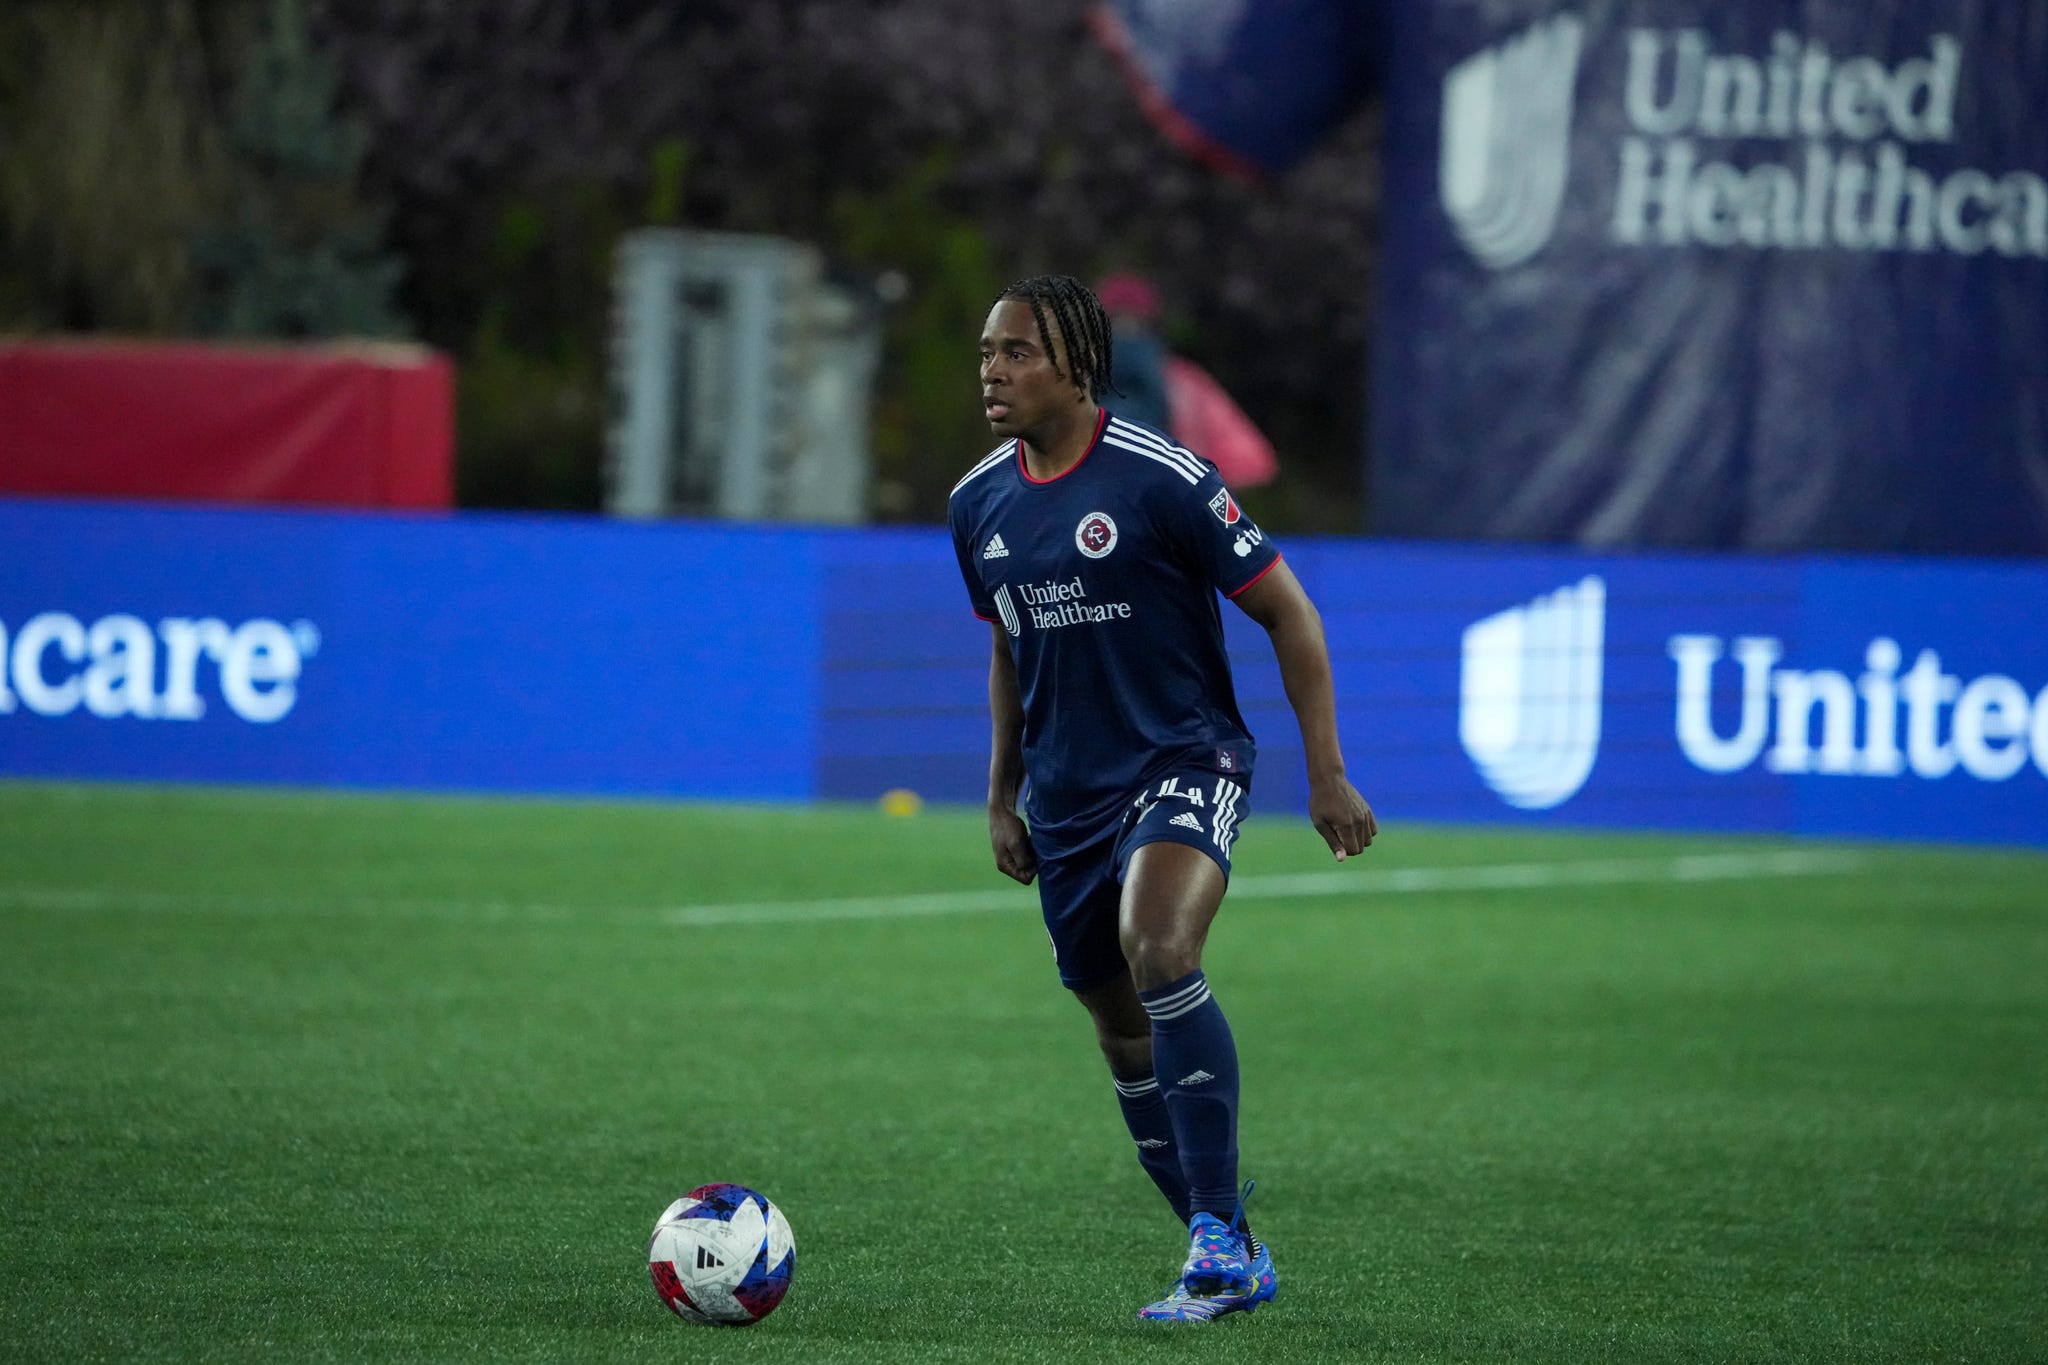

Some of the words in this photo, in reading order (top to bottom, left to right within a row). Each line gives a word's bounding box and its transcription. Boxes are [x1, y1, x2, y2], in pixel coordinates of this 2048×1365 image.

[1622, 27, 1961, 143] United
[1211, 495, 1226, 510] MLS
[983, 548, 1010, 560] adidas
[1017, 576, 1087, 606] United
[0, 611, 303, 724] care
[1169, 818, 1205, 833] adidas
